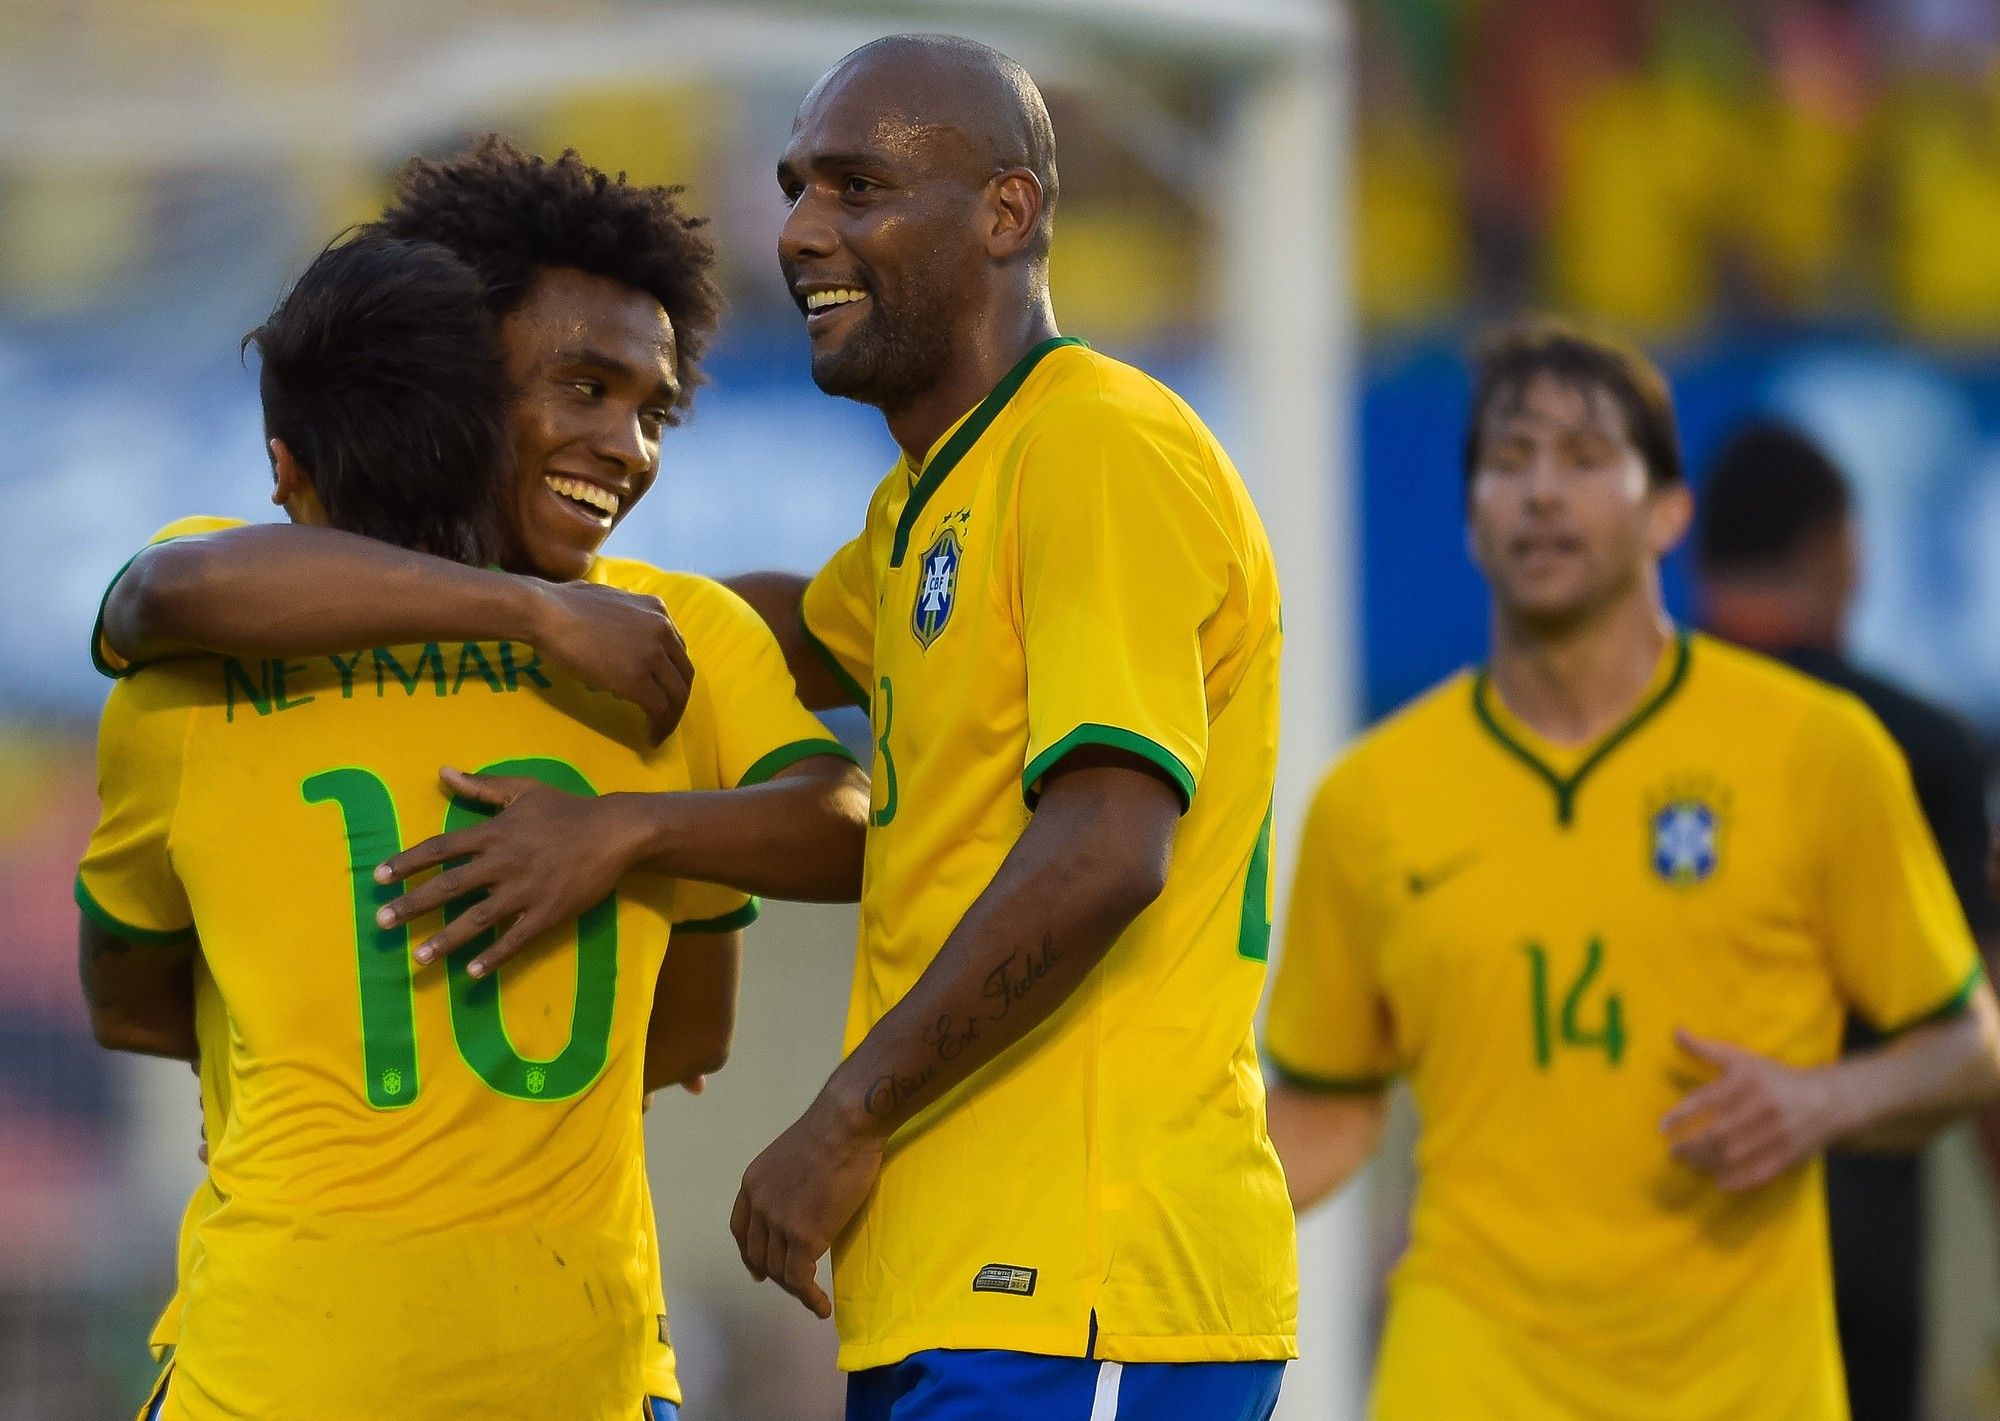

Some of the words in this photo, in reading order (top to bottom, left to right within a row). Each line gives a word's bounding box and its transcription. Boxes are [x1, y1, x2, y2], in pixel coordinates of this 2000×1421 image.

[929, 576, 945, 591] CBF
[223, 640, 552, 723] NEYMAR
[870, 675, 899, 827] 3
[300, 755, 619, 1110] 10
[1520, 935, 1627, 1072] 14
